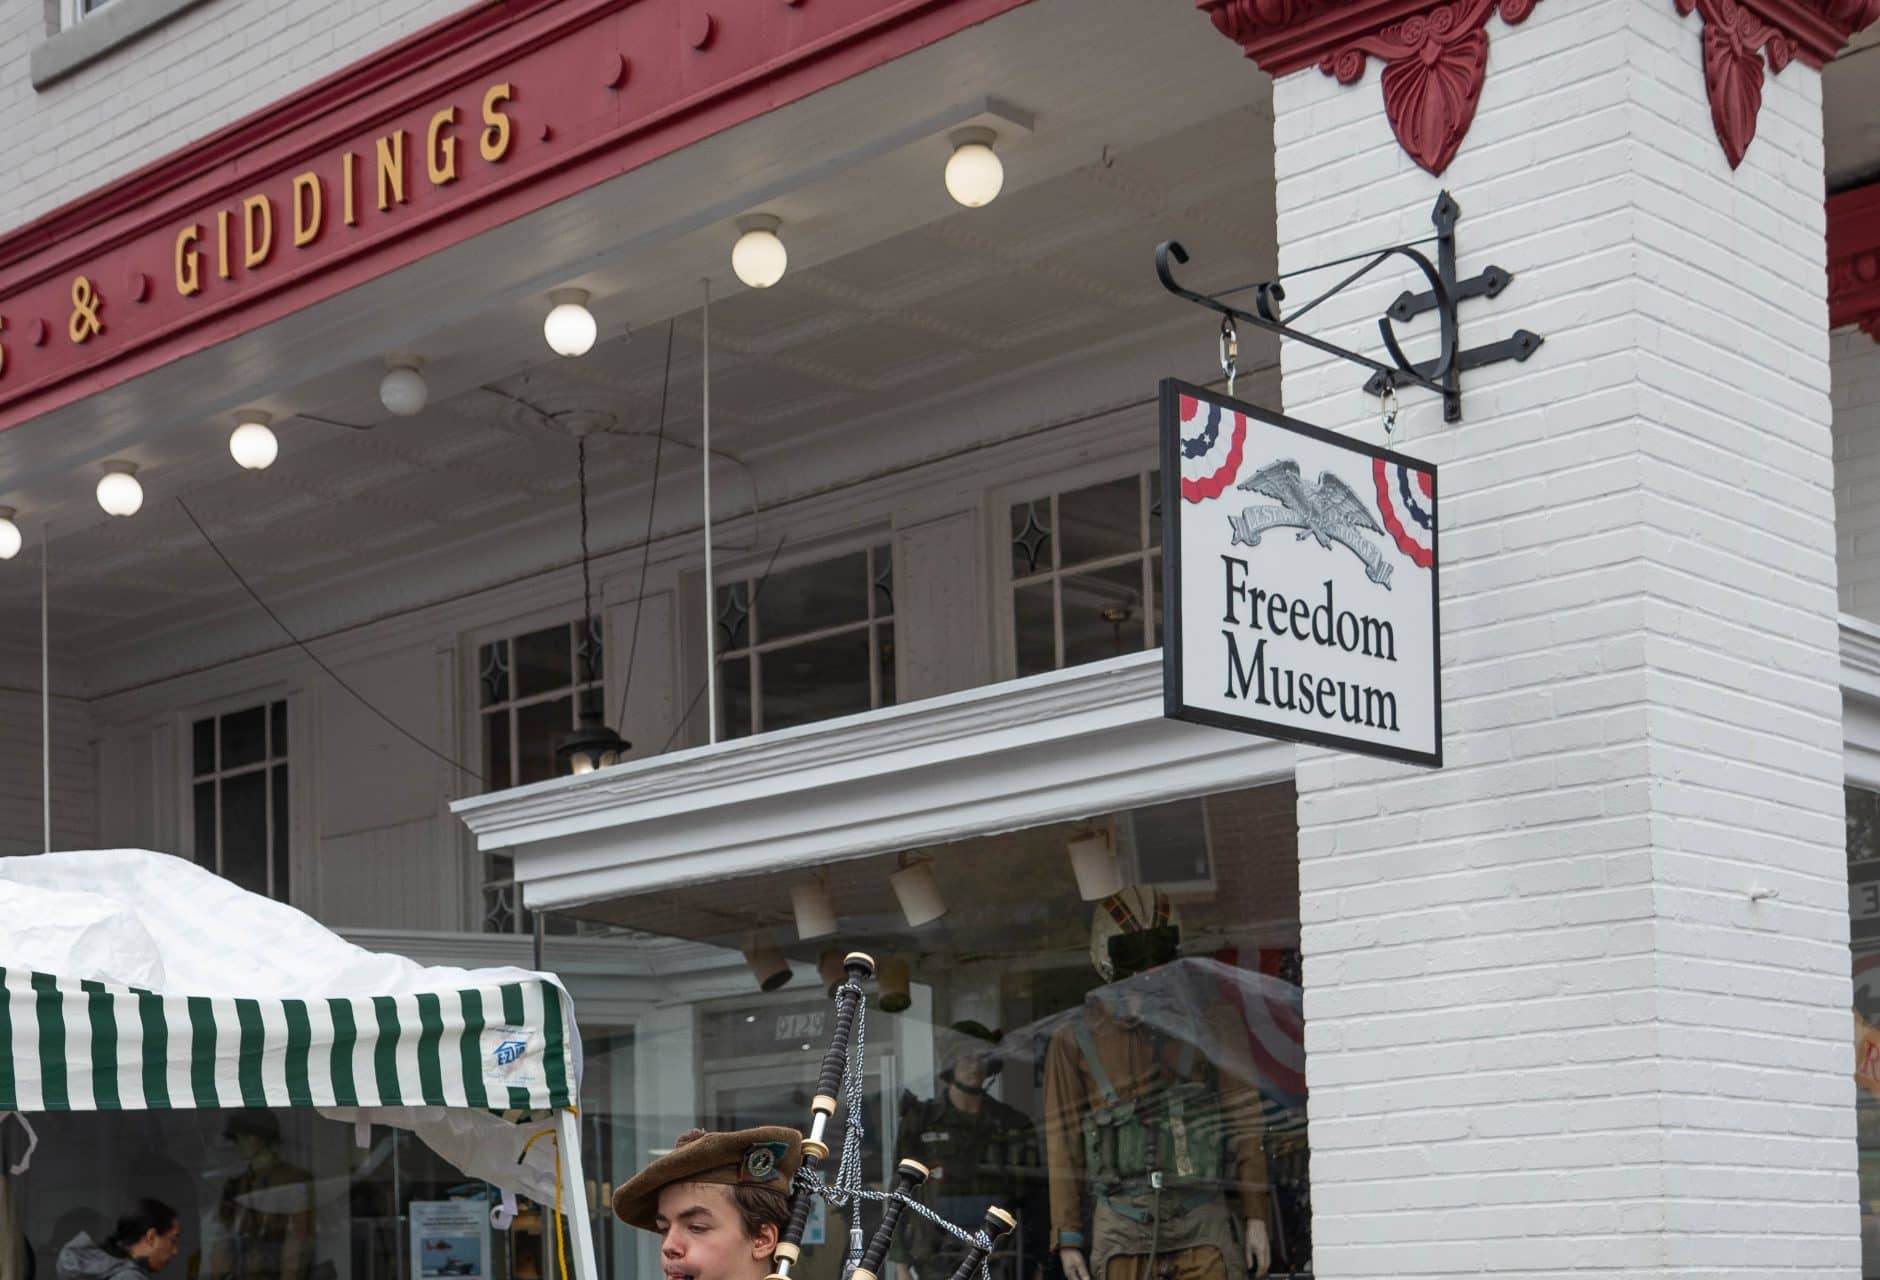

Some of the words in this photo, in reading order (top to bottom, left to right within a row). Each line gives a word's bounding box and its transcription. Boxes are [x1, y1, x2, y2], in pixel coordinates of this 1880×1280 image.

[69, 275, 100, 343] &
[175, 82, 510, 296] GIDDINGS
[1220, 554, 1397, 662] Freedom
[1222, 629, 1400, 732] Museum
